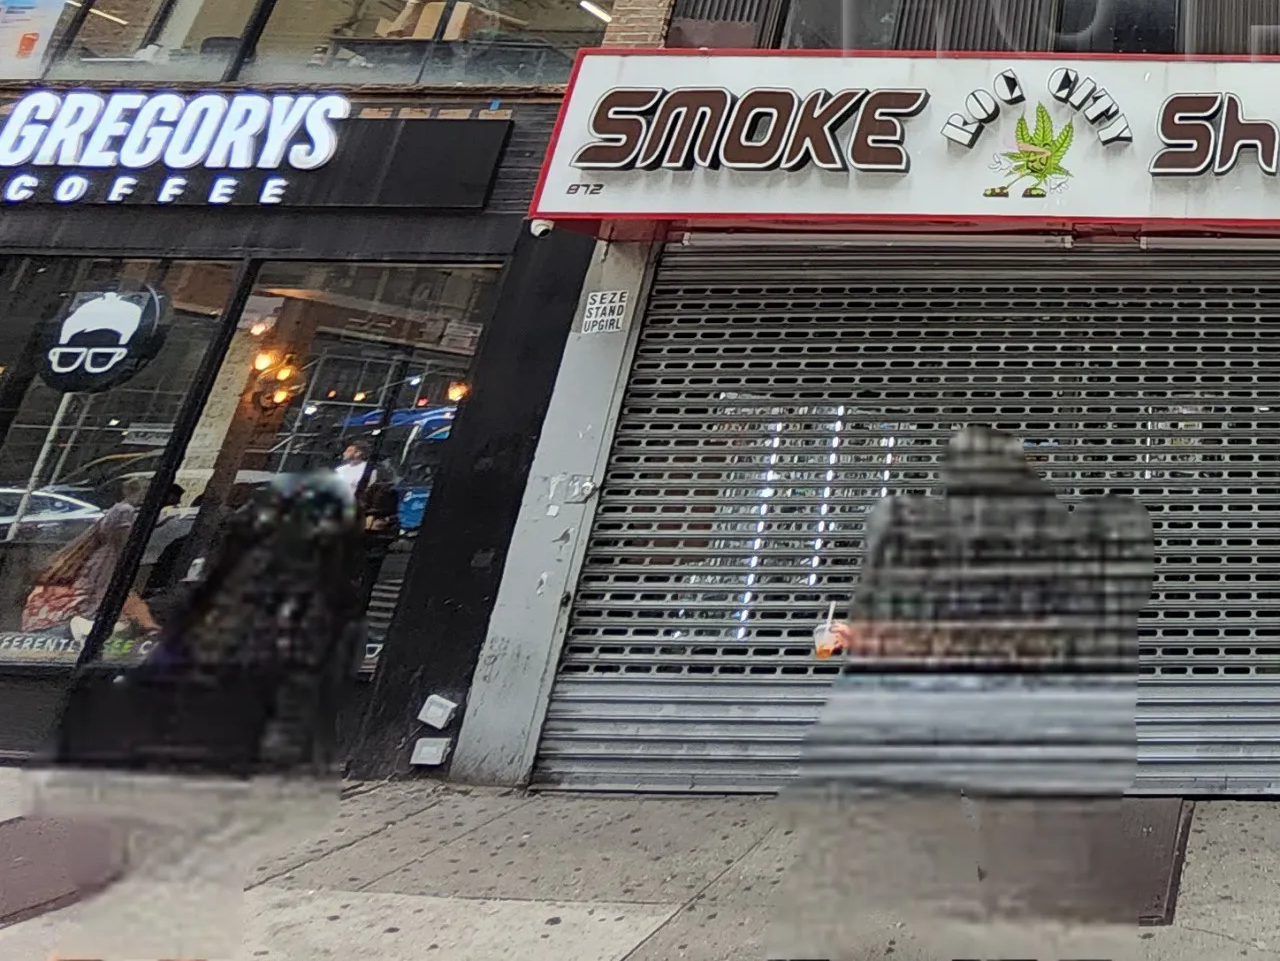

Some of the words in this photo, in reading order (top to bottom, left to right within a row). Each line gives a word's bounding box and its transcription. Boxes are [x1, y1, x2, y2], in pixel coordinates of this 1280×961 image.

[1047, 66, 1134, 146] CITY
[0, 91, 351, 170] GREGORYS
[570, 85, 931, 173] SMOKE
[4, 174, 289, 204] COFFEE
[566, 183, 604, 195] 872
[589, 291, 628, 306] SEZE
[586, 304, 624, 318] STAND
[583, 318, 621, 333] UPGIRL
